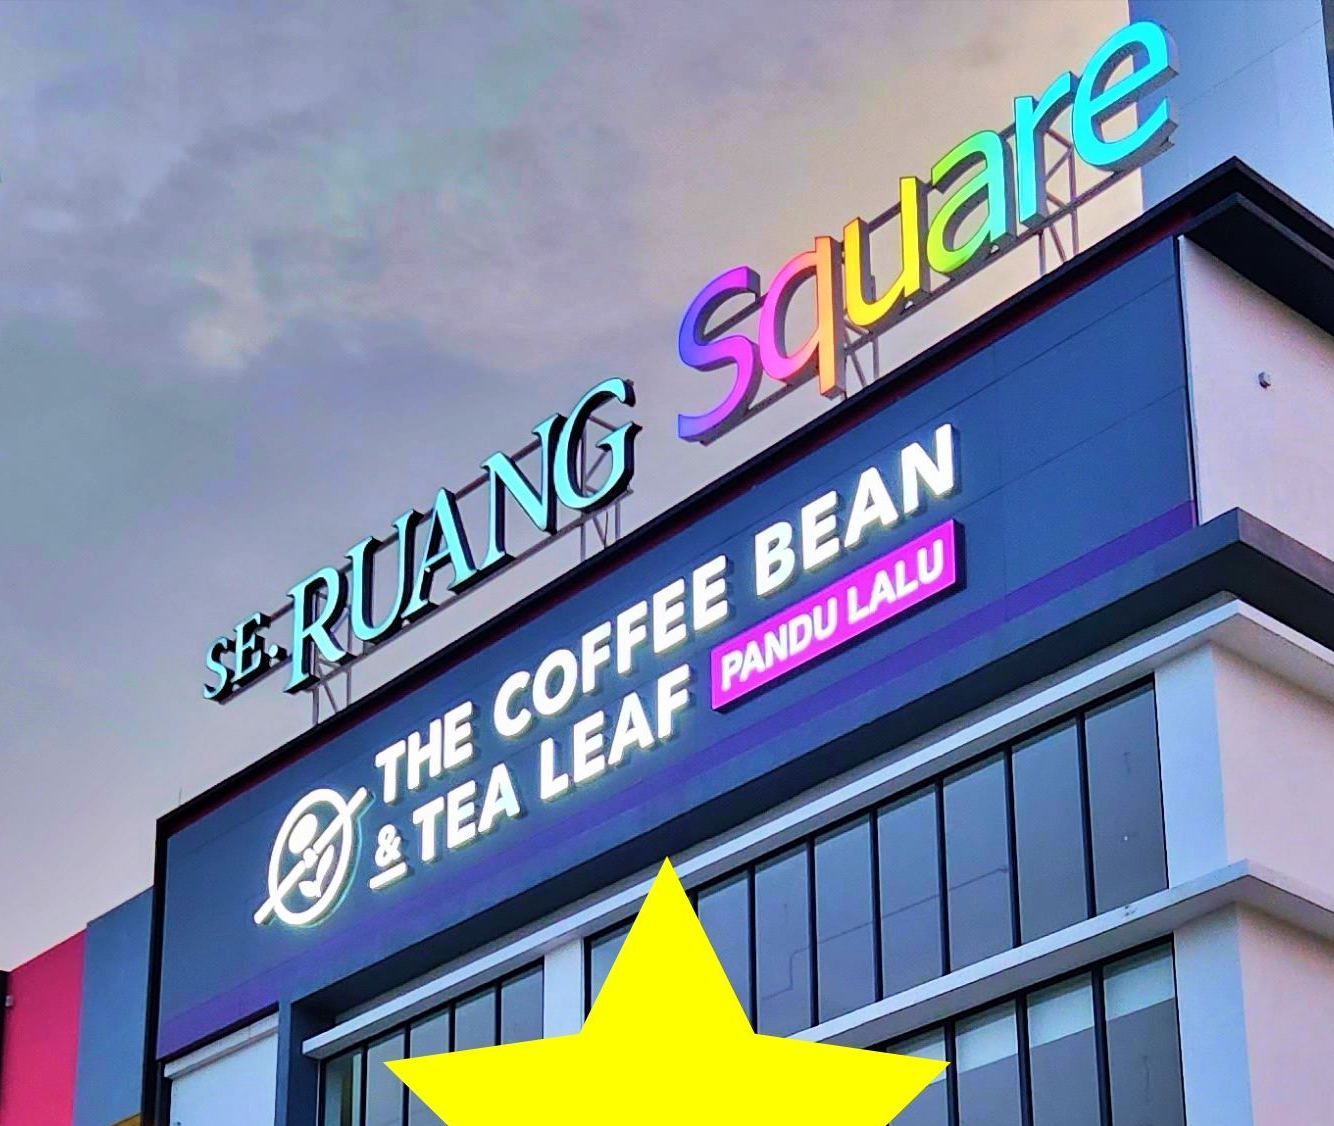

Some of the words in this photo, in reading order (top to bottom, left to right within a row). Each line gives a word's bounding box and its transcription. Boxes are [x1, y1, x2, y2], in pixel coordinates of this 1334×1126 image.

[677, 21, 1175, 442] Square
[374, 698, 475, 804] THE
[494, 554, 729, 738] COFFEE
[753, 422, 957, 597] BEAN
[720, 596, 839, 692] PANDU
[846, 538, 944, 625] LALU
[412, 762, 521, 863] TEA
[536, 664, 692, 798] LEAF
